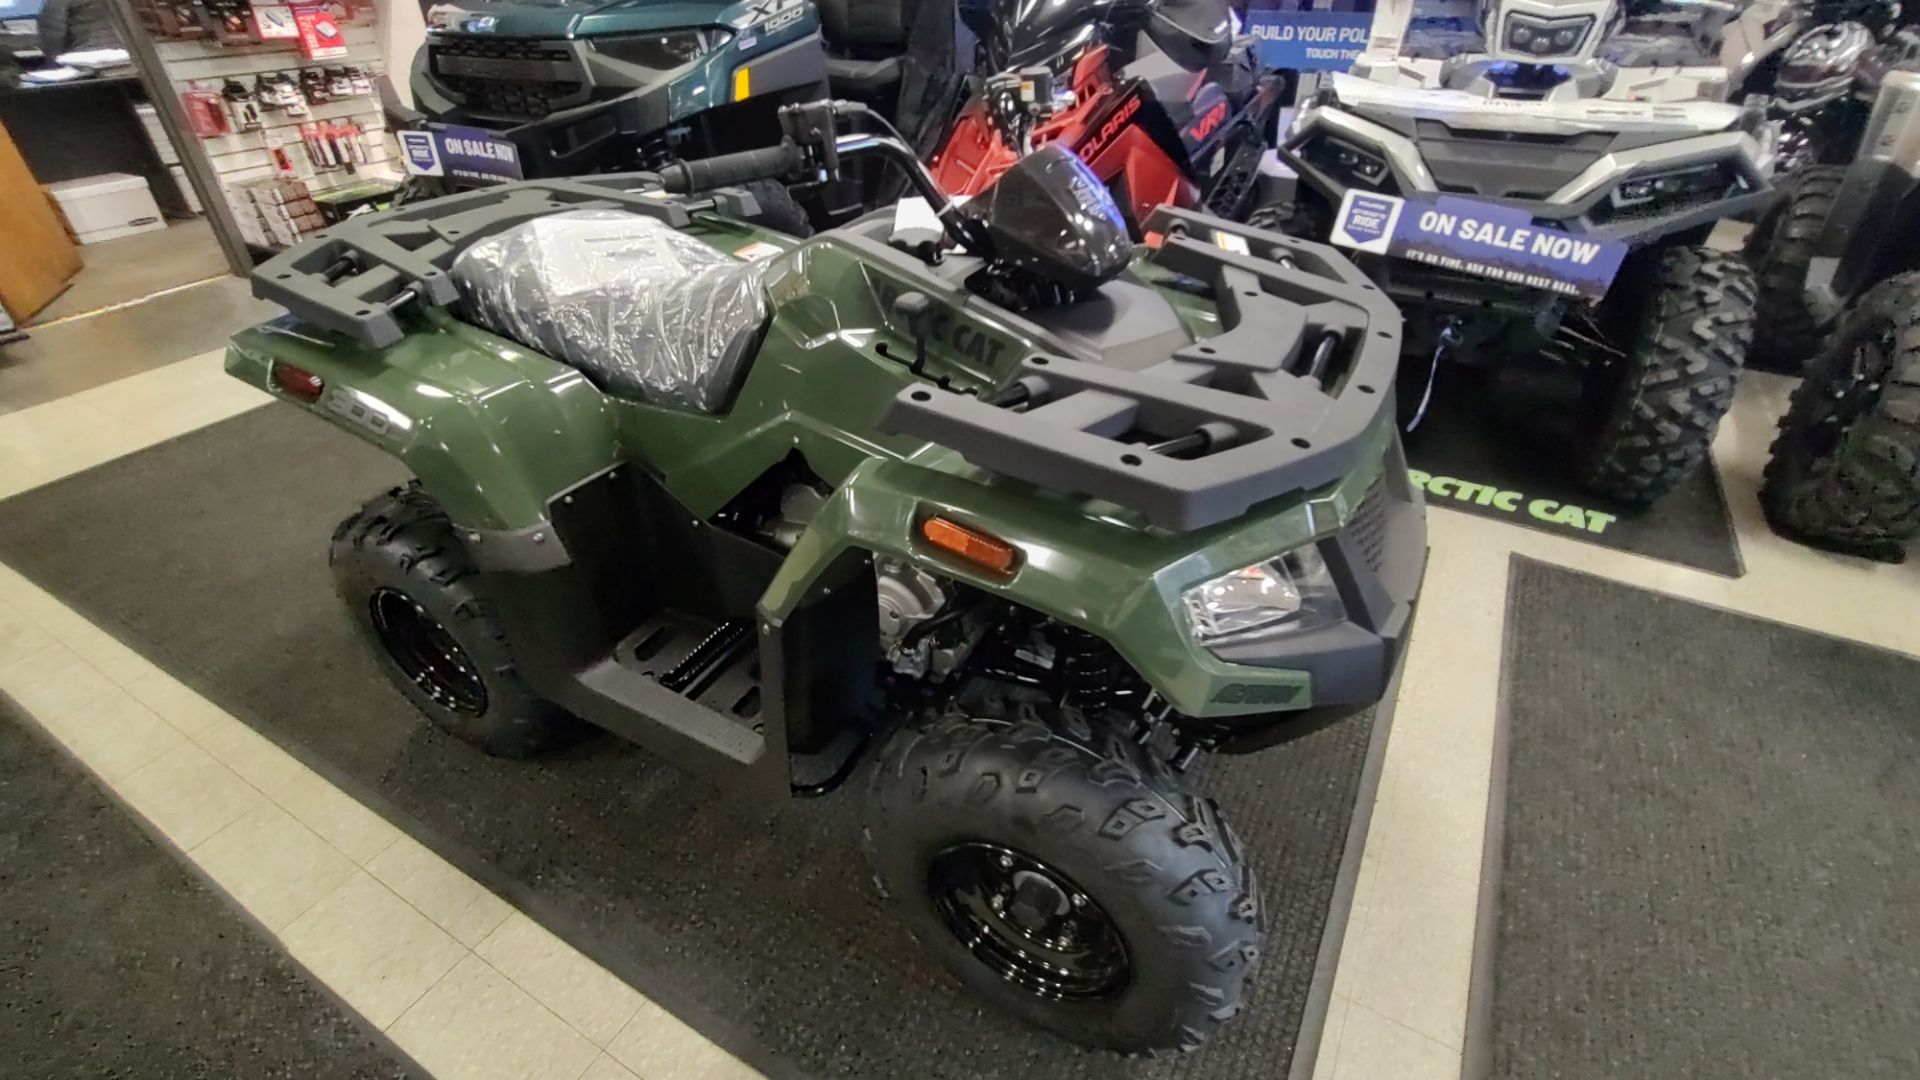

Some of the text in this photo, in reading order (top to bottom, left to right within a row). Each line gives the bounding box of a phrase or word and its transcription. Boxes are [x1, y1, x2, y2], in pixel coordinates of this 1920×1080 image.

[764, 6, 804, 32] 1000
[1252, 24, 1369, 44] BUILD YOUR POL
[1305, 47, 1339, 60] TOUCH
[1079, 95, 1141, 162] OLARIS
[444, 138, 464, 156] ON
[463, 140, 496, 159] SALE
[1419, 210, 1601, 265] ON SALE NOW
[1465, 262, 1484, 274] ASK
[1485, 265, 1504, 278] FOR
[1505, 270, 1525, 283] OUR
[1525, 274, 1550, 288] BEST
[1551, 280, 1581, 296] DEAL.
[953, 324, 1006, 367] CAT
[1408, 469, 1616, 534] RCTIC CAT
